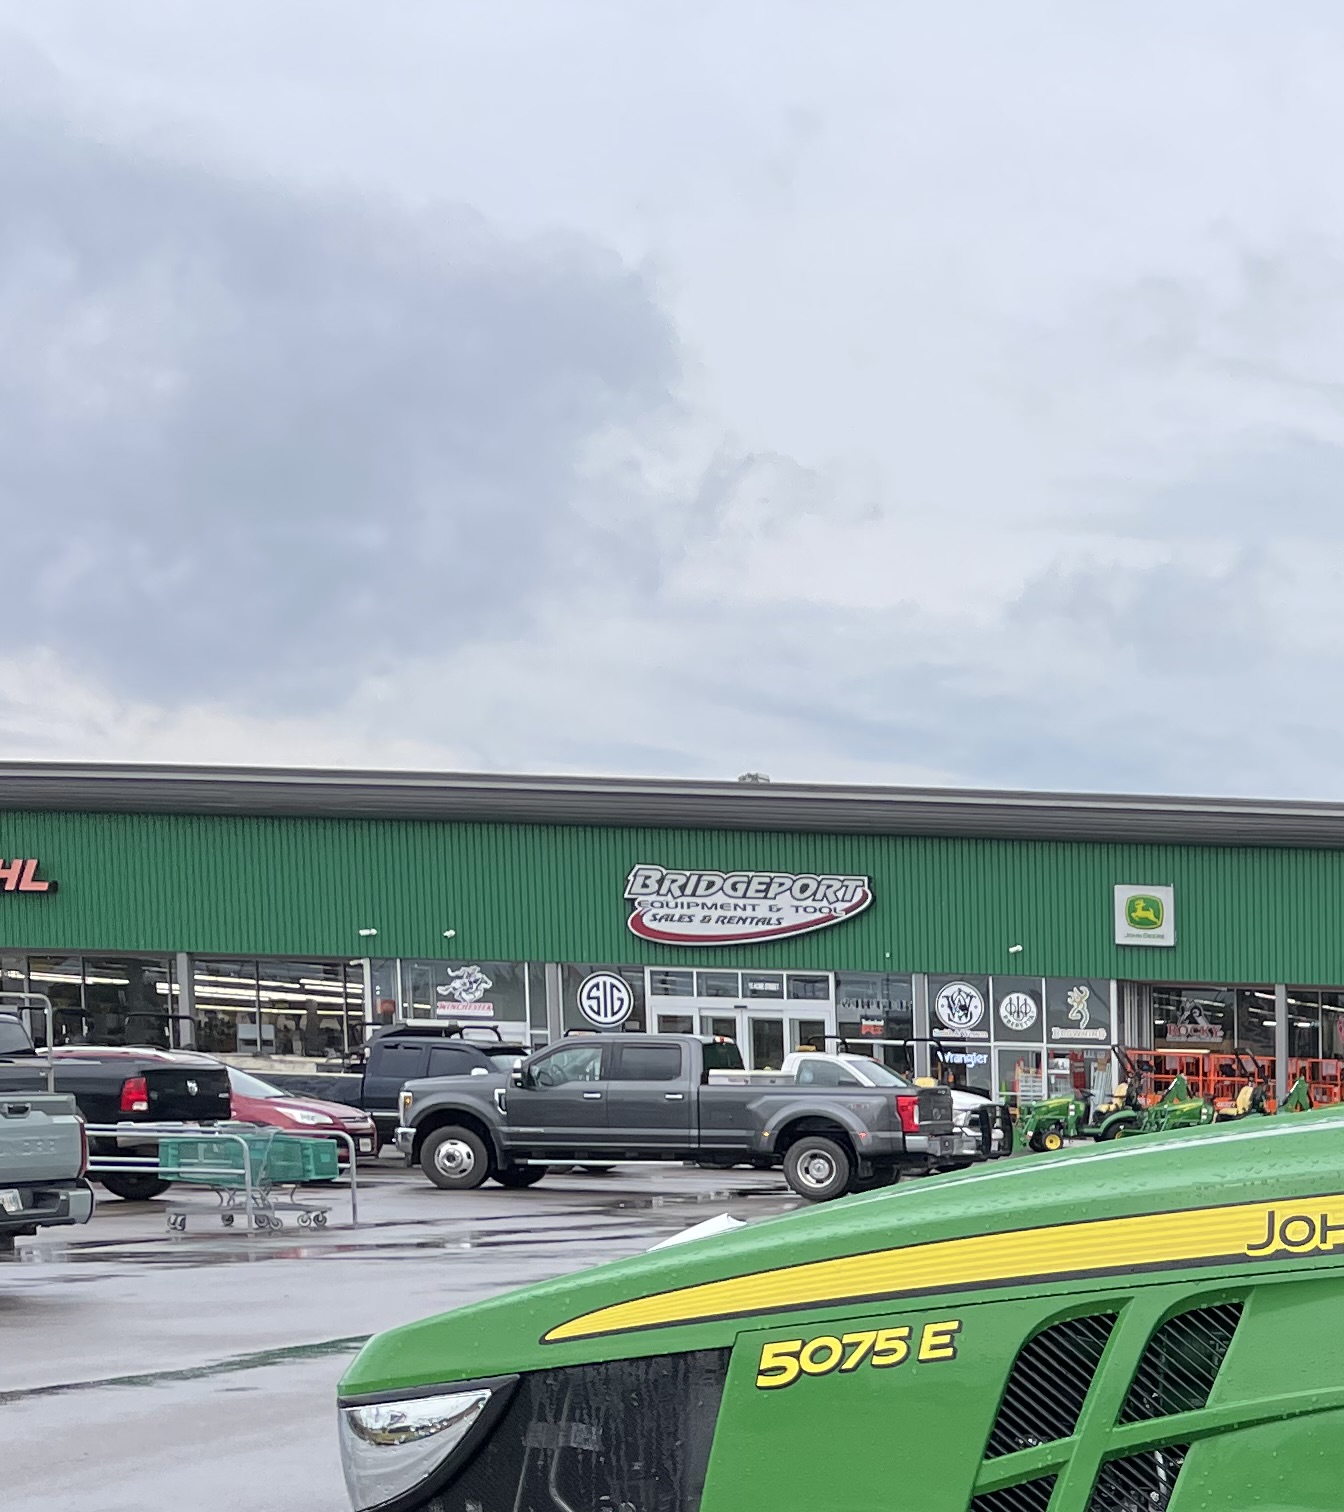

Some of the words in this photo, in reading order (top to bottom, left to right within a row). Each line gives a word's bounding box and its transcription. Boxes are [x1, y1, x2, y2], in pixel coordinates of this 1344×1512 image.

[628, 868, 864, 904] BRIDGEPORT
[637, 899, 760, 912] EQUIPMENT
[768, 903, 782, 912] &
[790, 904, 845, 917] TOOL
[649, 912, 695, 923] SALES
[701, 914, 711, 923] &
[715, 914, 784, 926] RENTALS
[586, 981, 624, 1018] SIG
[1167, 1024, 1224, 1037] ROCKY
[936, 1051, 988, 1069] Wrangler
[755, 1325, 913, 1390] 5075
[917, 1319, 963, 1363] E
